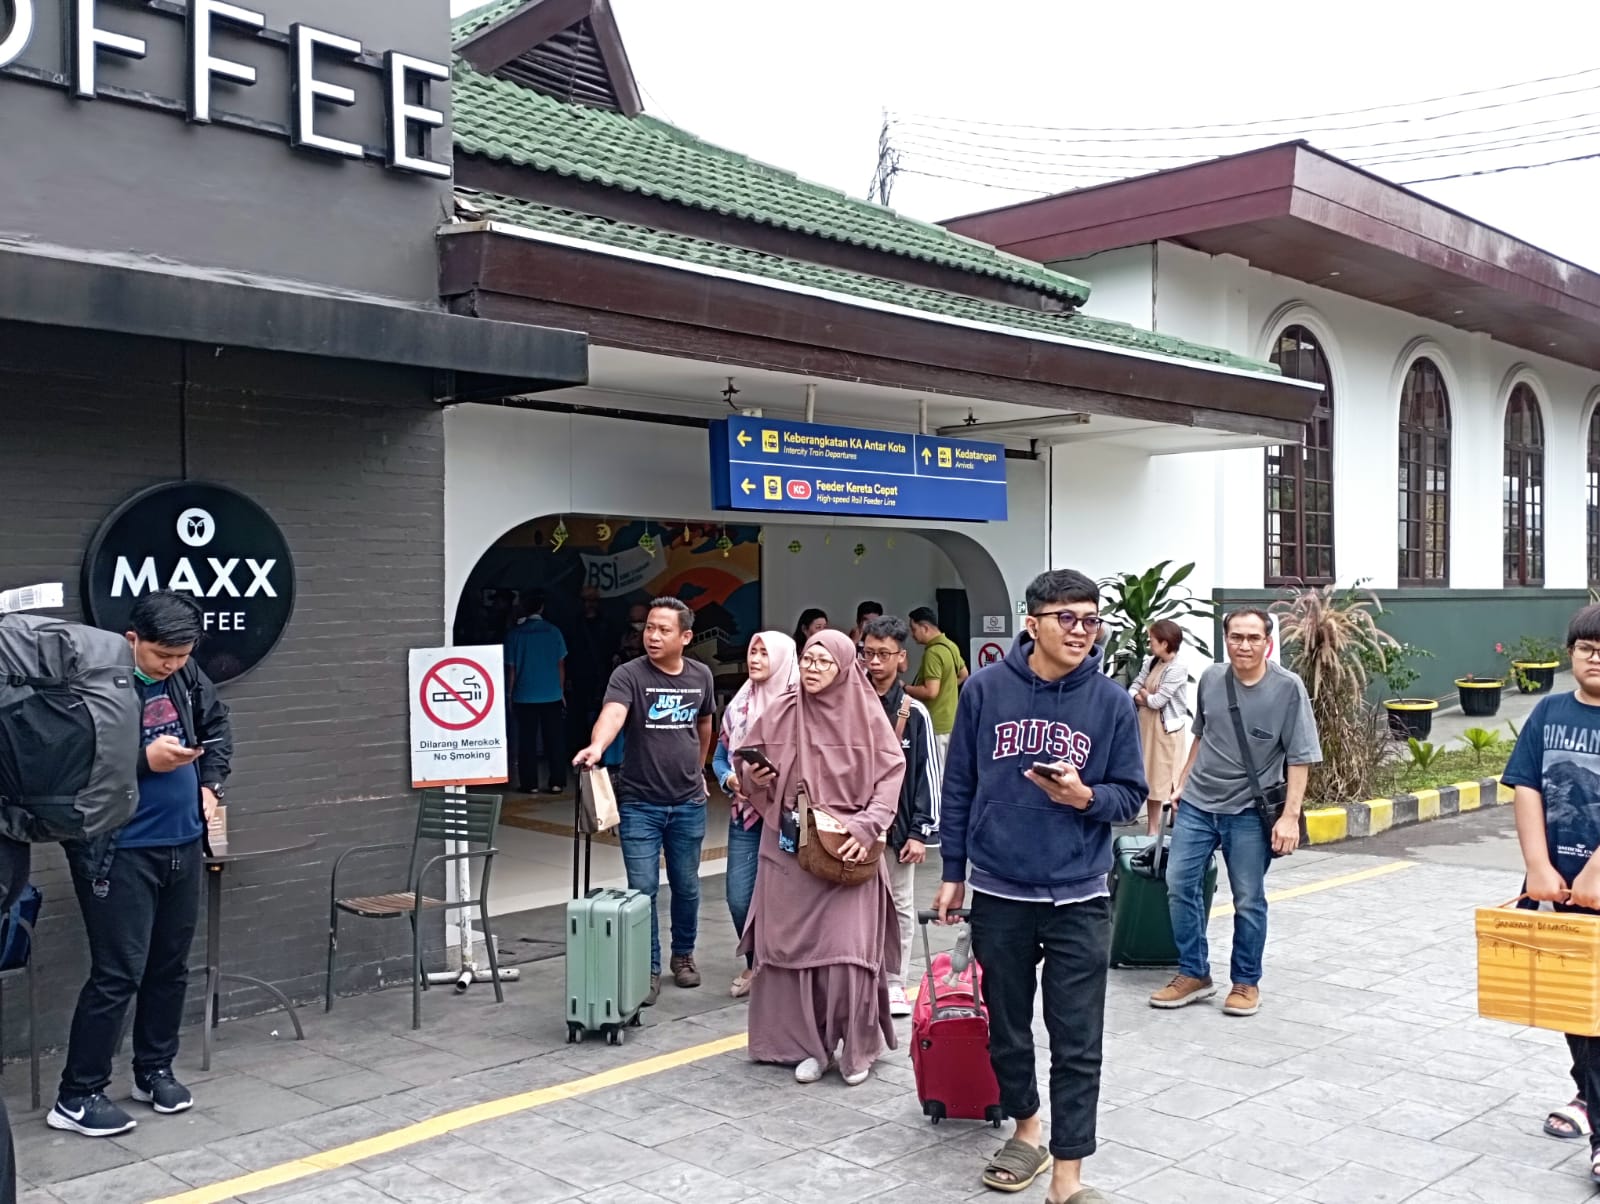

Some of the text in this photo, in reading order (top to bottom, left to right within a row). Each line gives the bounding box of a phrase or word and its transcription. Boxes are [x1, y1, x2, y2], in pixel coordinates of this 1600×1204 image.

[0, 0, 452, 179] FFEE
[783, 431, 906, 453] Keberangkatan KA Antar Kota
[783, 446, 857, 460] Intercity Train Departures
[955, 448, 997, 463] Kedatangan
[955, 462, 975, 470] Arrivals
[793, 485, 805, 494] KC
[816, 480, 898, 496] Feeder Kereta Cepat
[816, 494, 896, 507] High-speed Rail Feeder Line
[110, 556, 278, 598] MAXX
[656, 694, 683, 709] JUST
[420, 738, 500, 749] Dilarang Merokok
[992, 718, 1092, 770] RUSS
[433, 751, 491, 760] No Smoking
